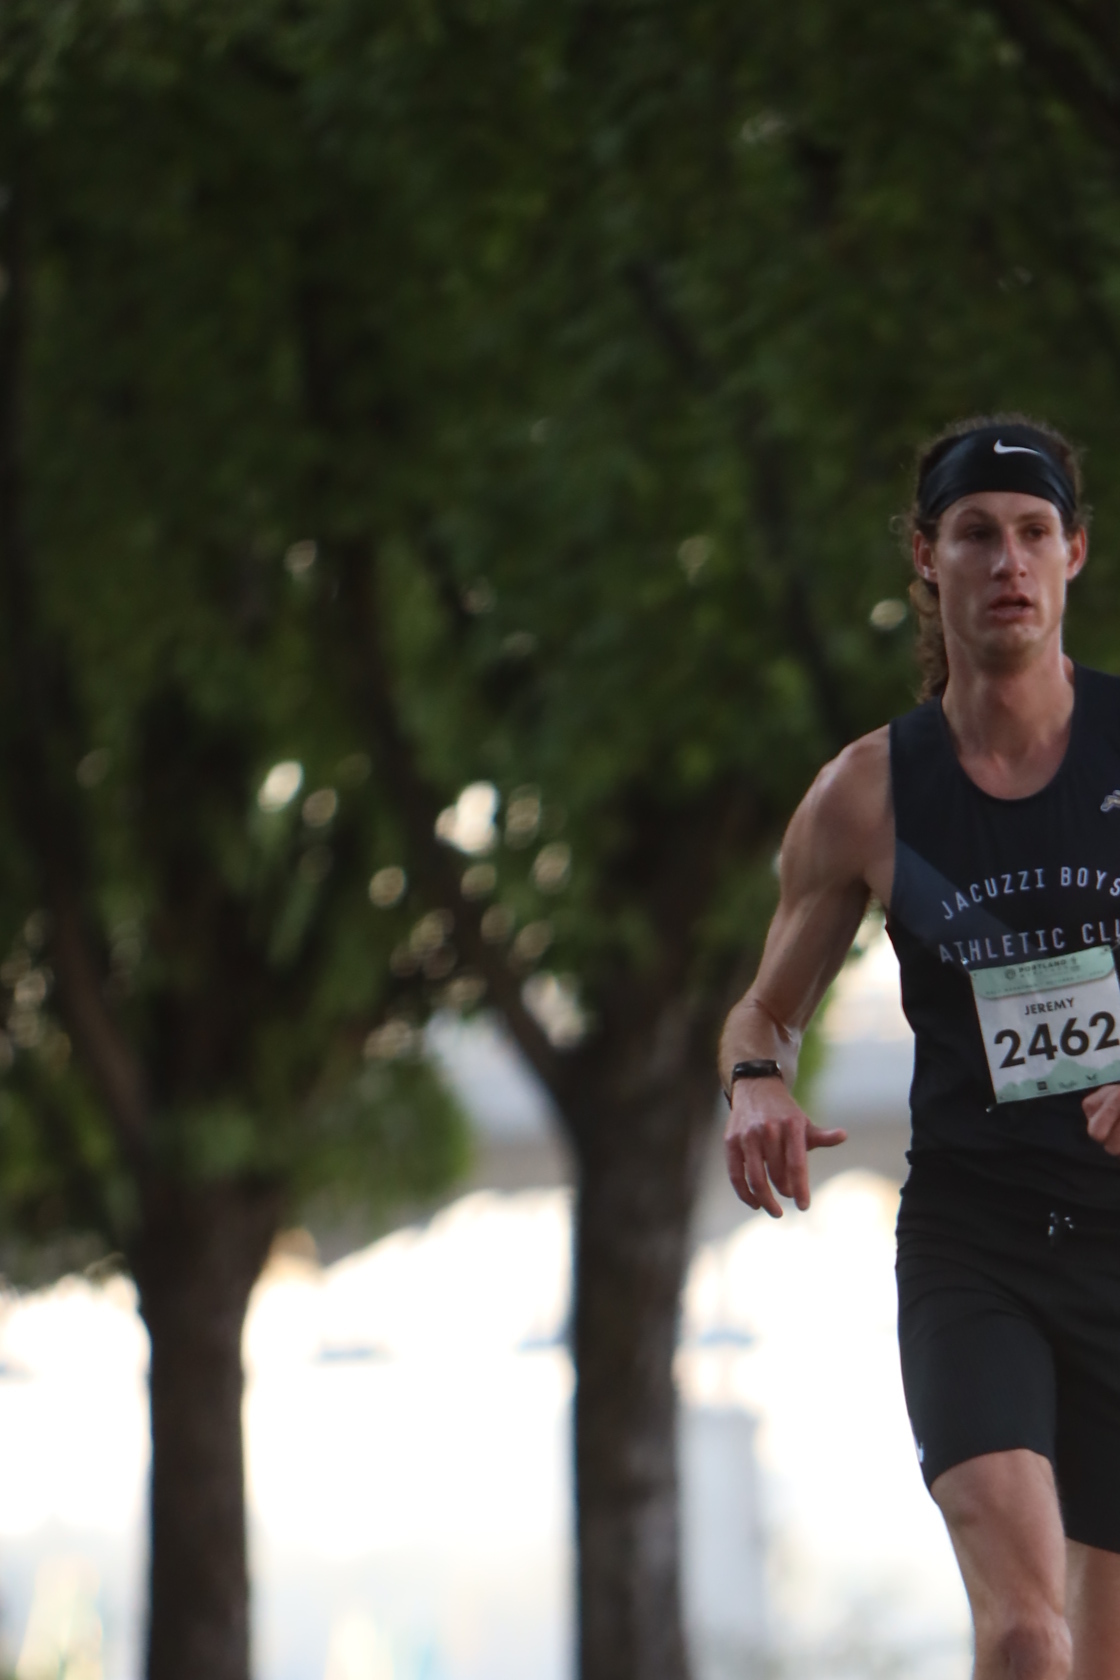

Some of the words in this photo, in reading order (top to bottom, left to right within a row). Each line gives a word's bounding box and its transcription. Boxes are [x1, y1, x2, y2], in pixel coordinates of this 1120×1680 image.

[941, 868, 1045, 920] JACUZZI
[938, 927, 1066, 963] ATHLETIC
[1024, 997, 1075, 1016] JEREMY
[993, 1011, 1120, 1069] 2462
